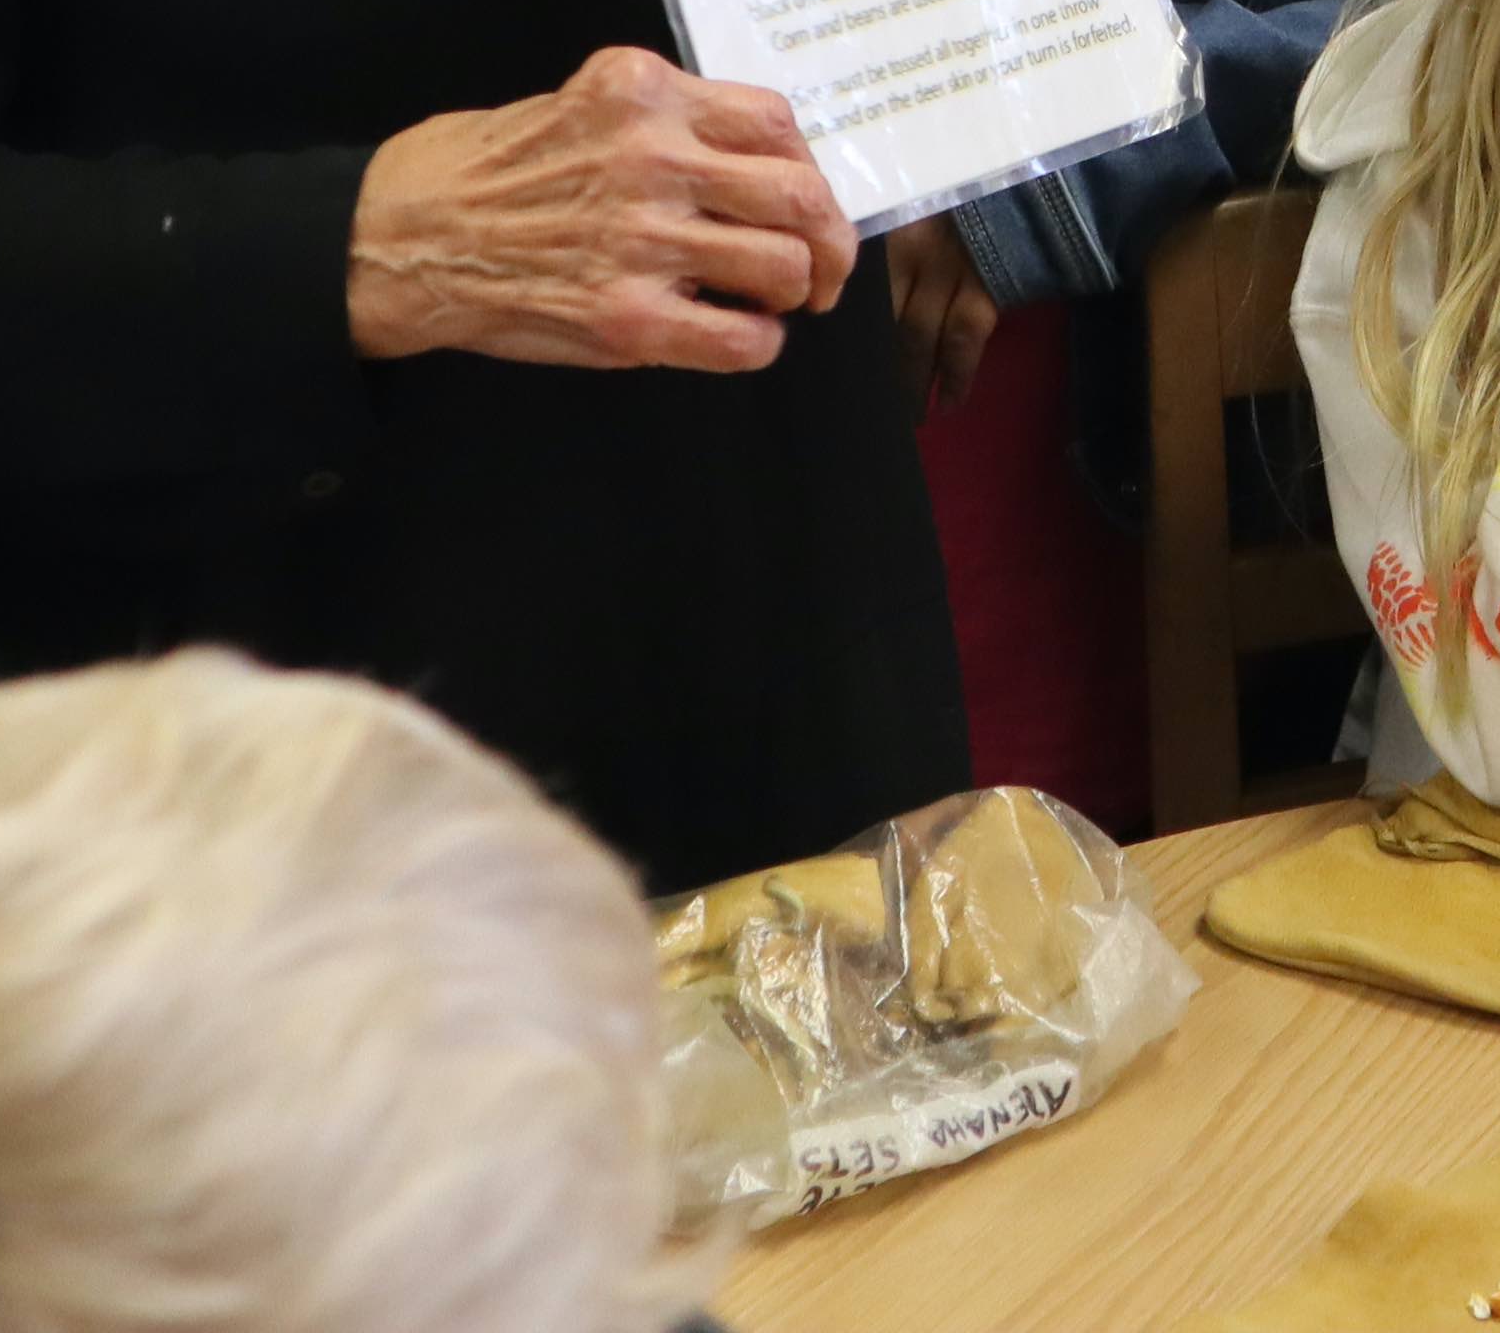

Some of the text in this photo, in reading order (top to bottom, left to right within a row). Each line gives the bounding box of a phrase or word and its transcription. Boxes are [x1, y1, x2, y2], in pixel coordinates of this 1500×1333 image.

[1026, 43, 1059, 68] turn
[1059, 36, 1072, 56] is
[1071, 13, 1137, 51] forfeited.
[1031, 8, 1058, 30] one
[798, 1135, 900, 1183] SETS
